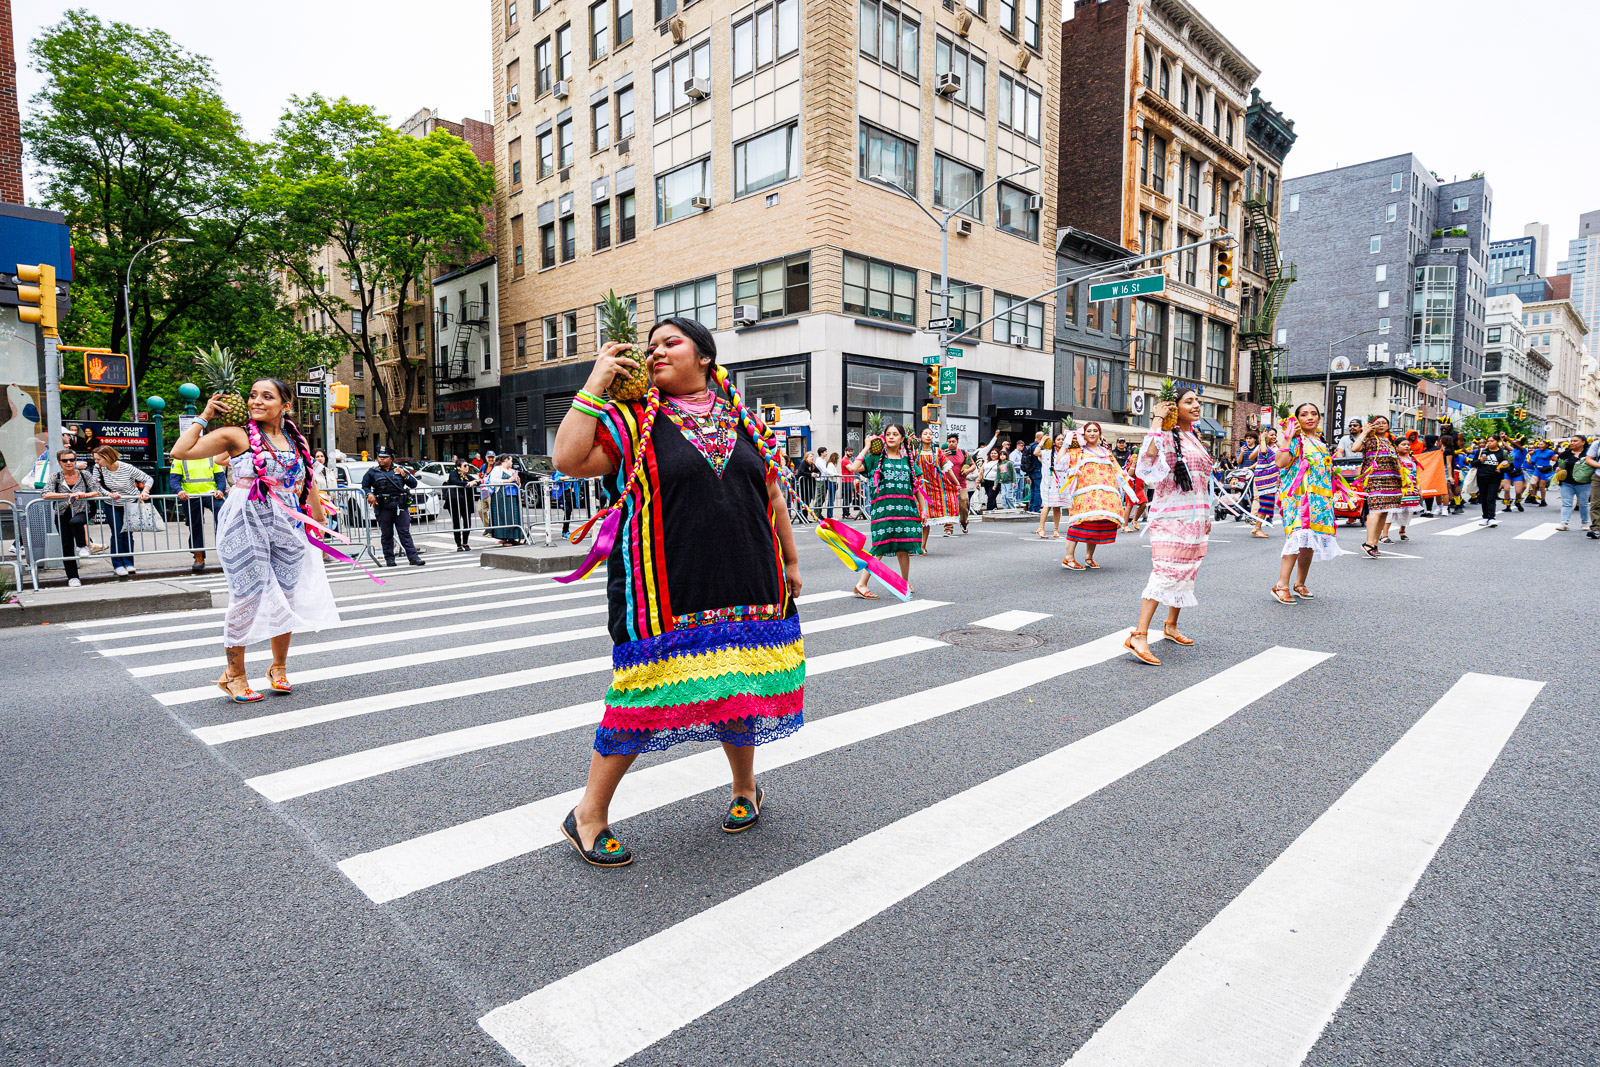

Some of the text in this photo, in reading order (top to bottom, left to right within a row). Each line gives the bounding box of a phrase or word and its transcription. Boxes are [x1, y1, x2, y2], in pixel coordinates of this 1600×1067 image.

[1112, 284, 1140, 295] W 16 St
